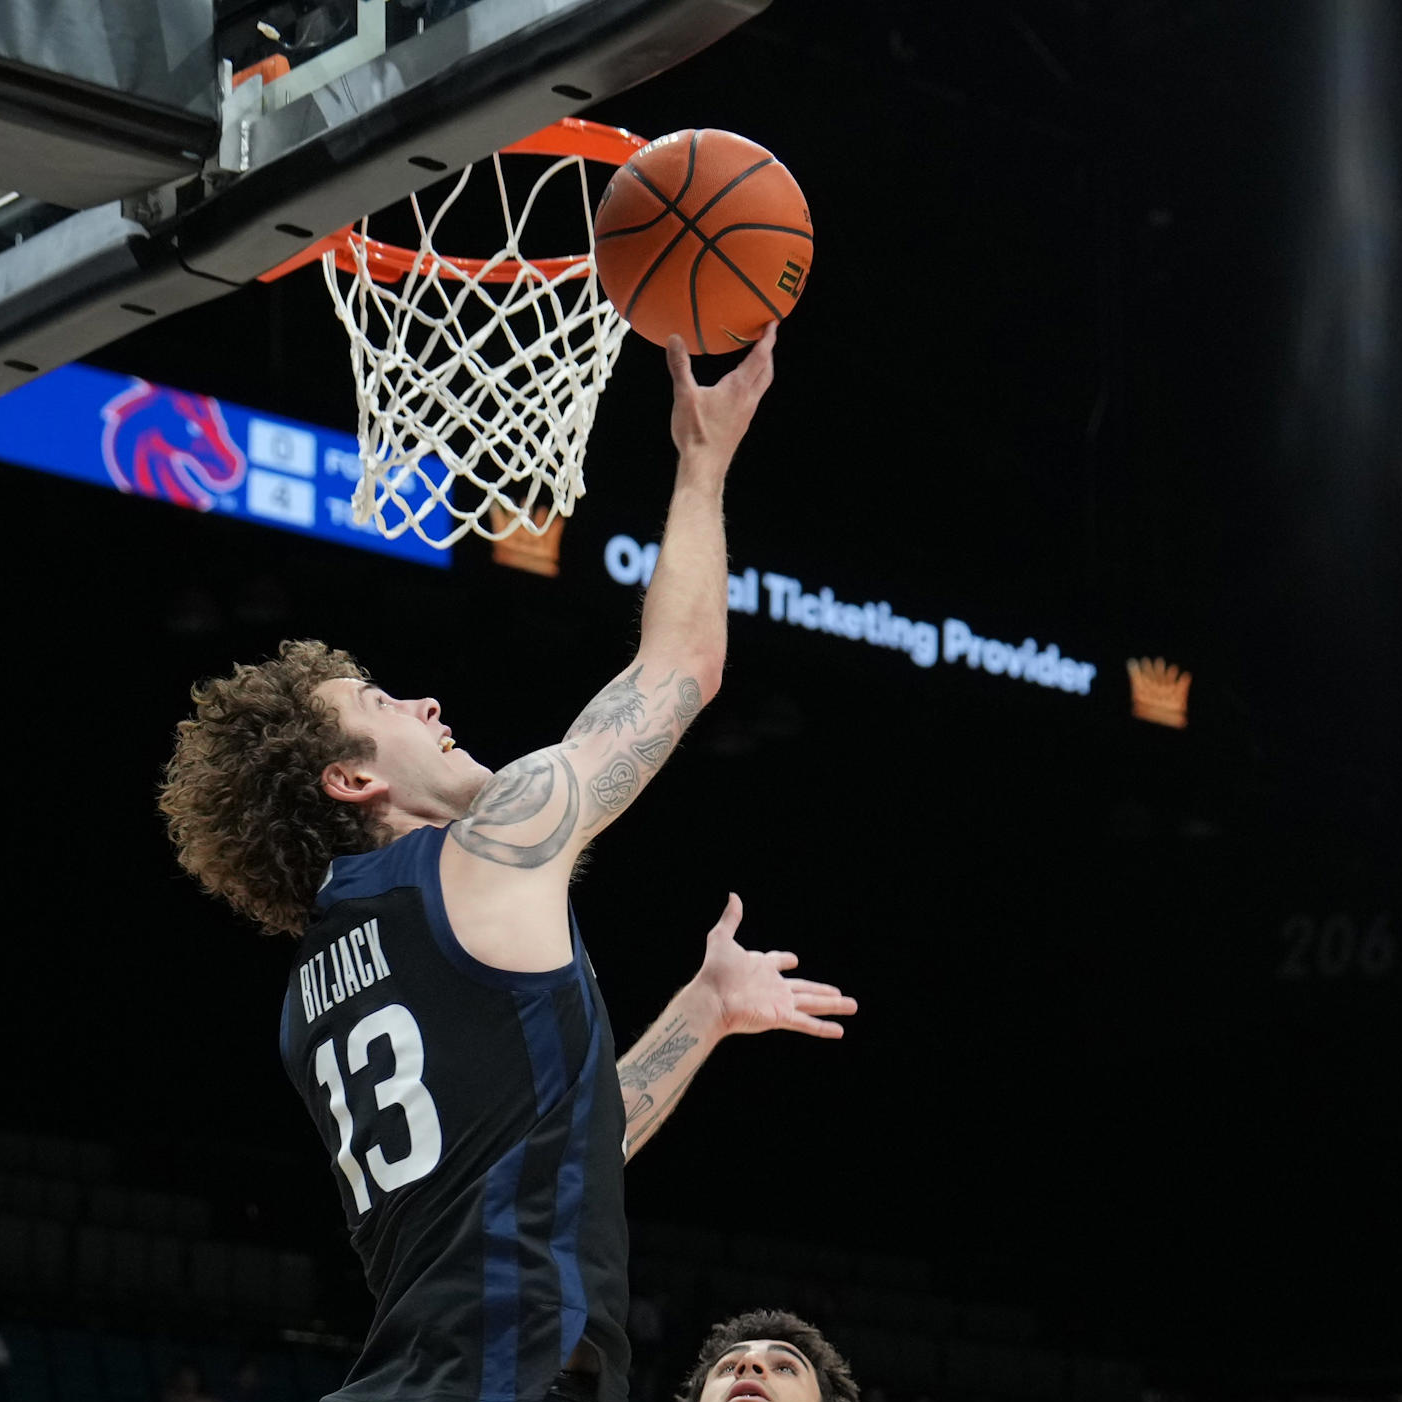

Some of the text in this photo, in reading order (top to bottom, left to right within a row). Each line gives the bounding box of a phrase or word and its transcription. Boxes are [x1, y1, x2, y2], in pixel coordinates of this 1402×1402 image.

[762, 571, 939, 669] Ticketing
[942, 617, 1097, 696] Provider
[299, 917, 392, 1025] BIZJACK
[1274, 911, 1397, 981] 206
[315, 1002, 443, 1215] 13
